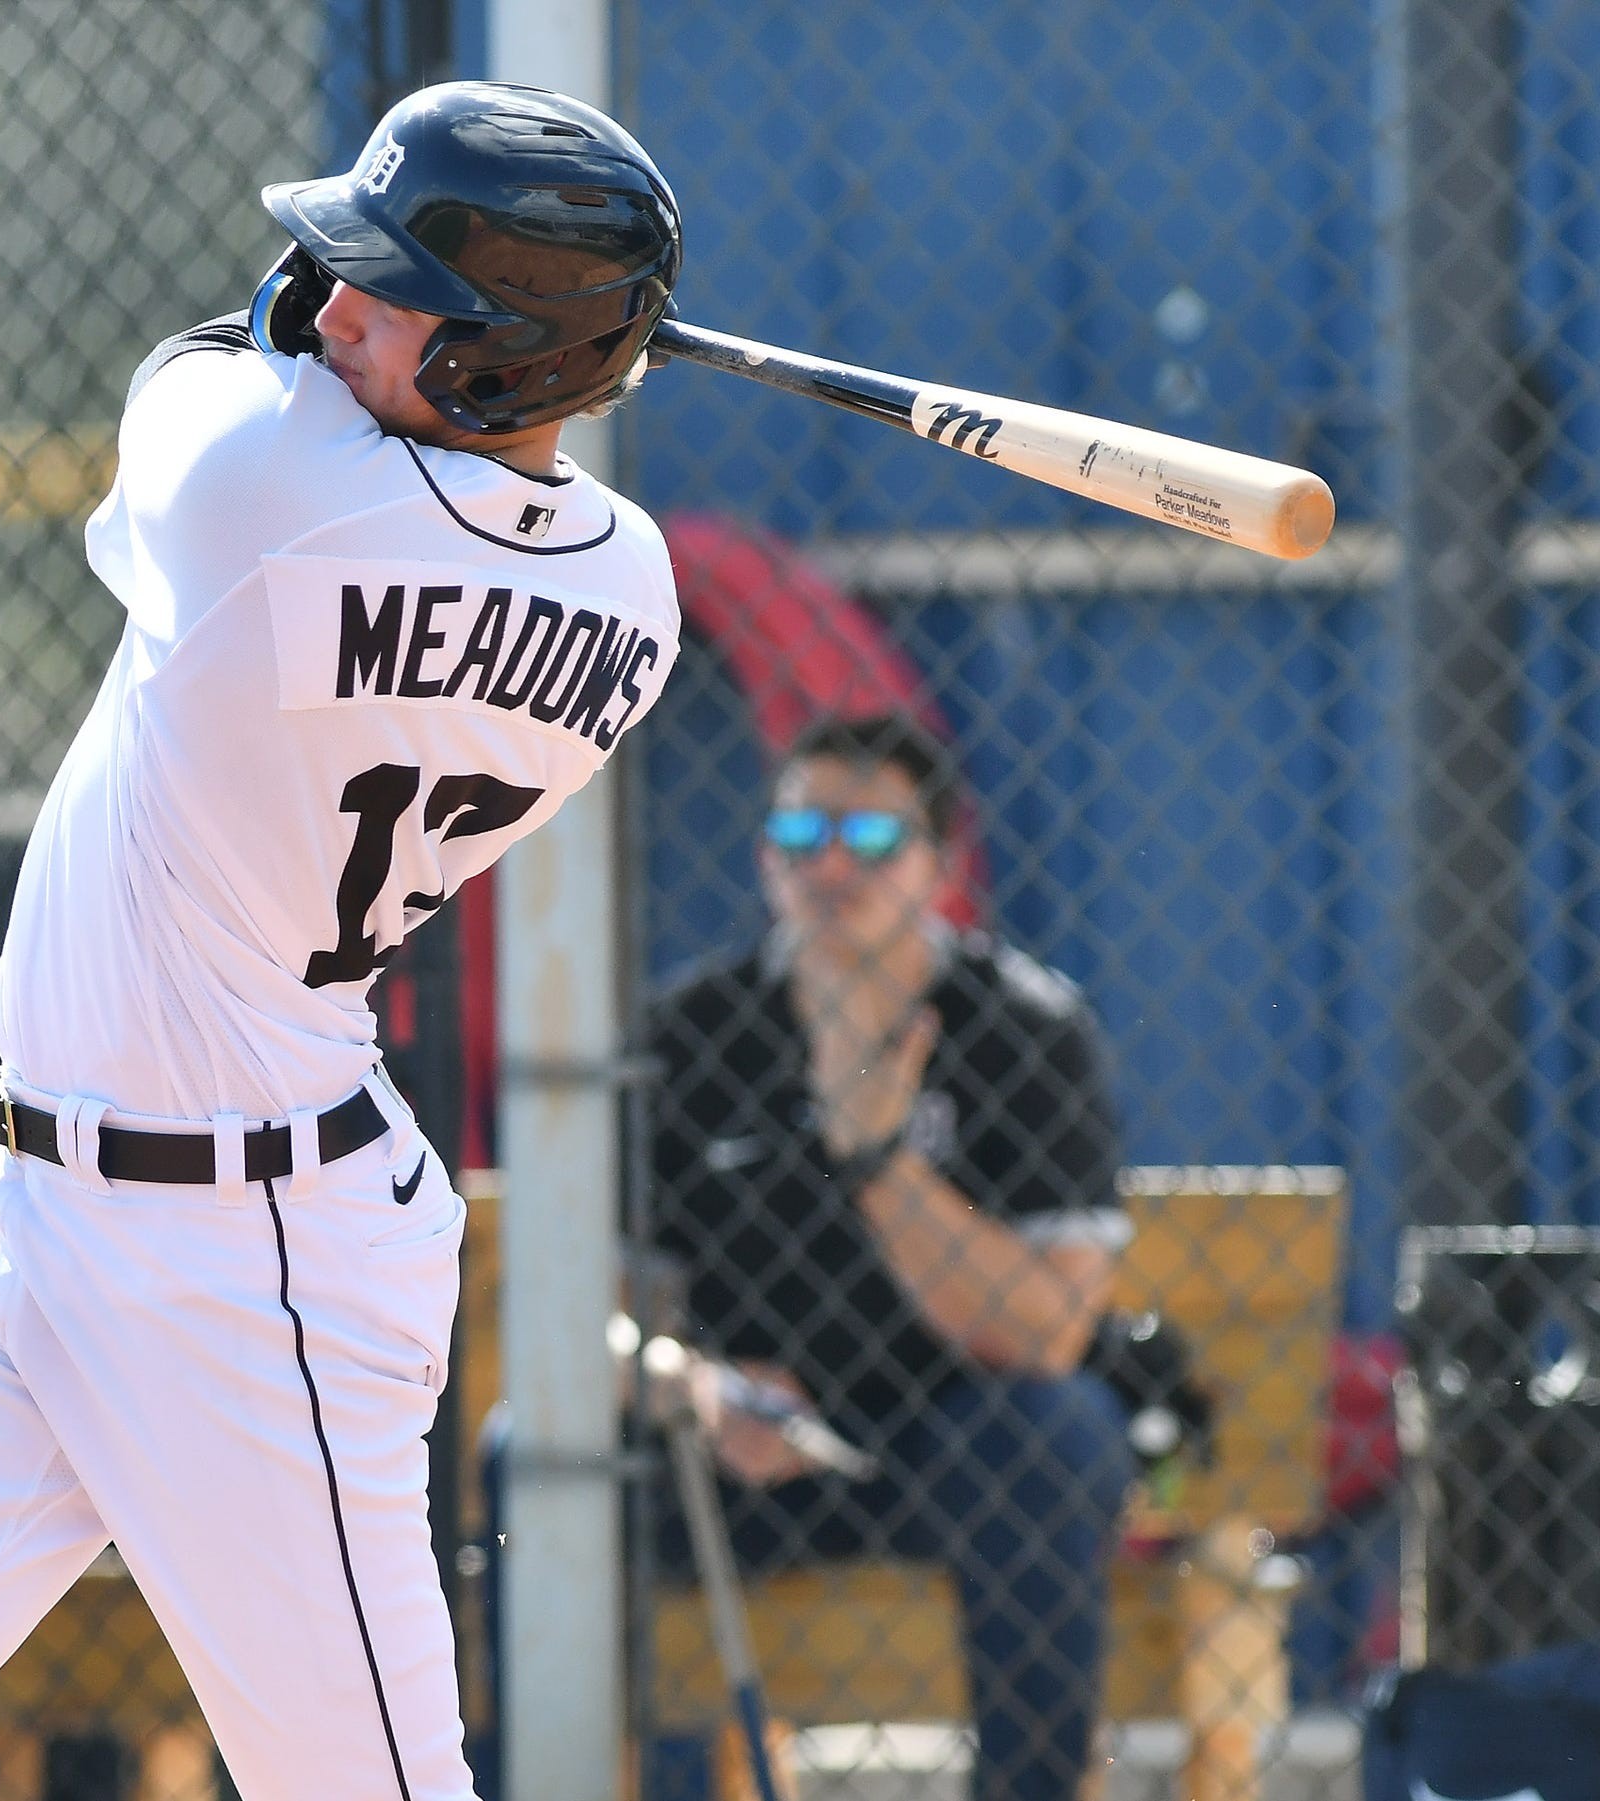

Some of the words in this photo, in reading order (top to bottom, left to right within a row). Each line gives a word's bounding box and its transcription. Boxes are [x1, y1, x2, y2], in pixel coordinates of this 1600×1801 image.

[356, 128, 406, 197] D
[1155, 493, 1185, 515] Parker
[1186, 502, 1231, 530] Meadows
[1163, 483, 1208, 506] Handcrafted
[1208, 498, 1222, 510] For
[335, 583, 660, 752] MEADOWS
